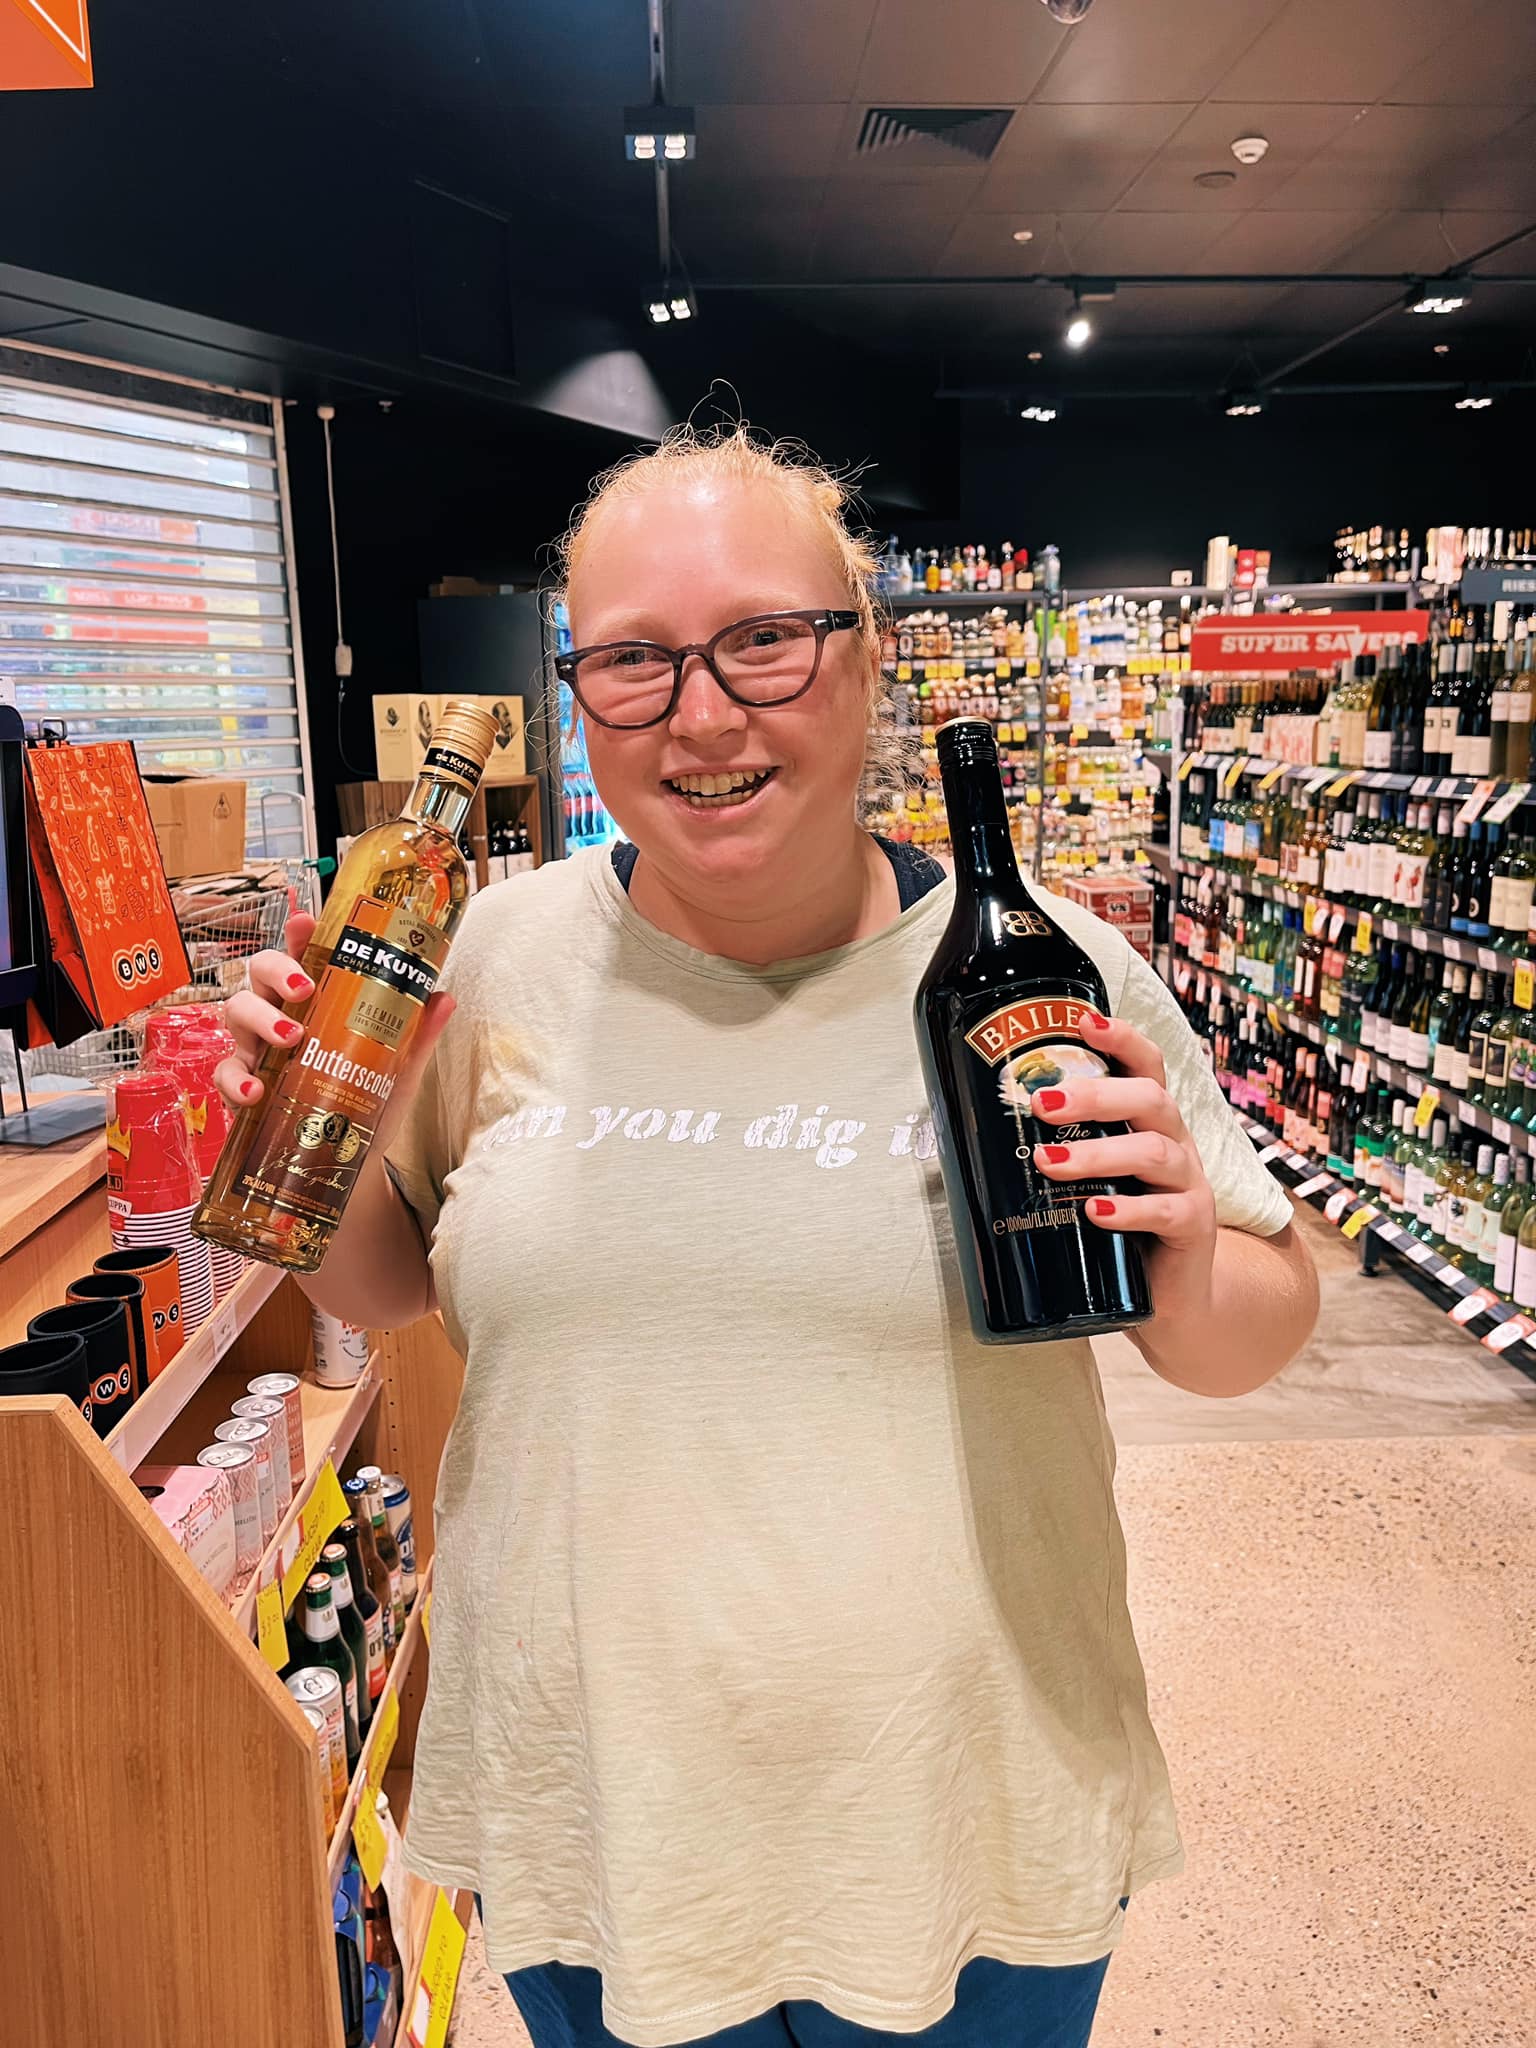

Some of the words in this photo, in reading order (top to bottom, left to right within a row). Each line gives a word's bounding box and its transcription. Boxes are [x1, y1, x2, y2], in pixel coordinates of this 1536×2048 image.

[1221, 634, 1309, 653] SUPER
[341, 938, 373, 959] DE
[121, 952, 158, 977] BWS
[357, 1001, 404, 1030] PREMIUM
[980, 1005, 1085, 1052] BAILE
[576, 1106, 721, 1149] you
[744, 1104, 866, 1169] dig
[1055, 1124, 1091, 1140] The
[1038, 1184, 1077, 1196] PRODUCT
[1044, 1207, 1077, 1231] LIQUEUR
[99, 1372, 129, 1396] WS
